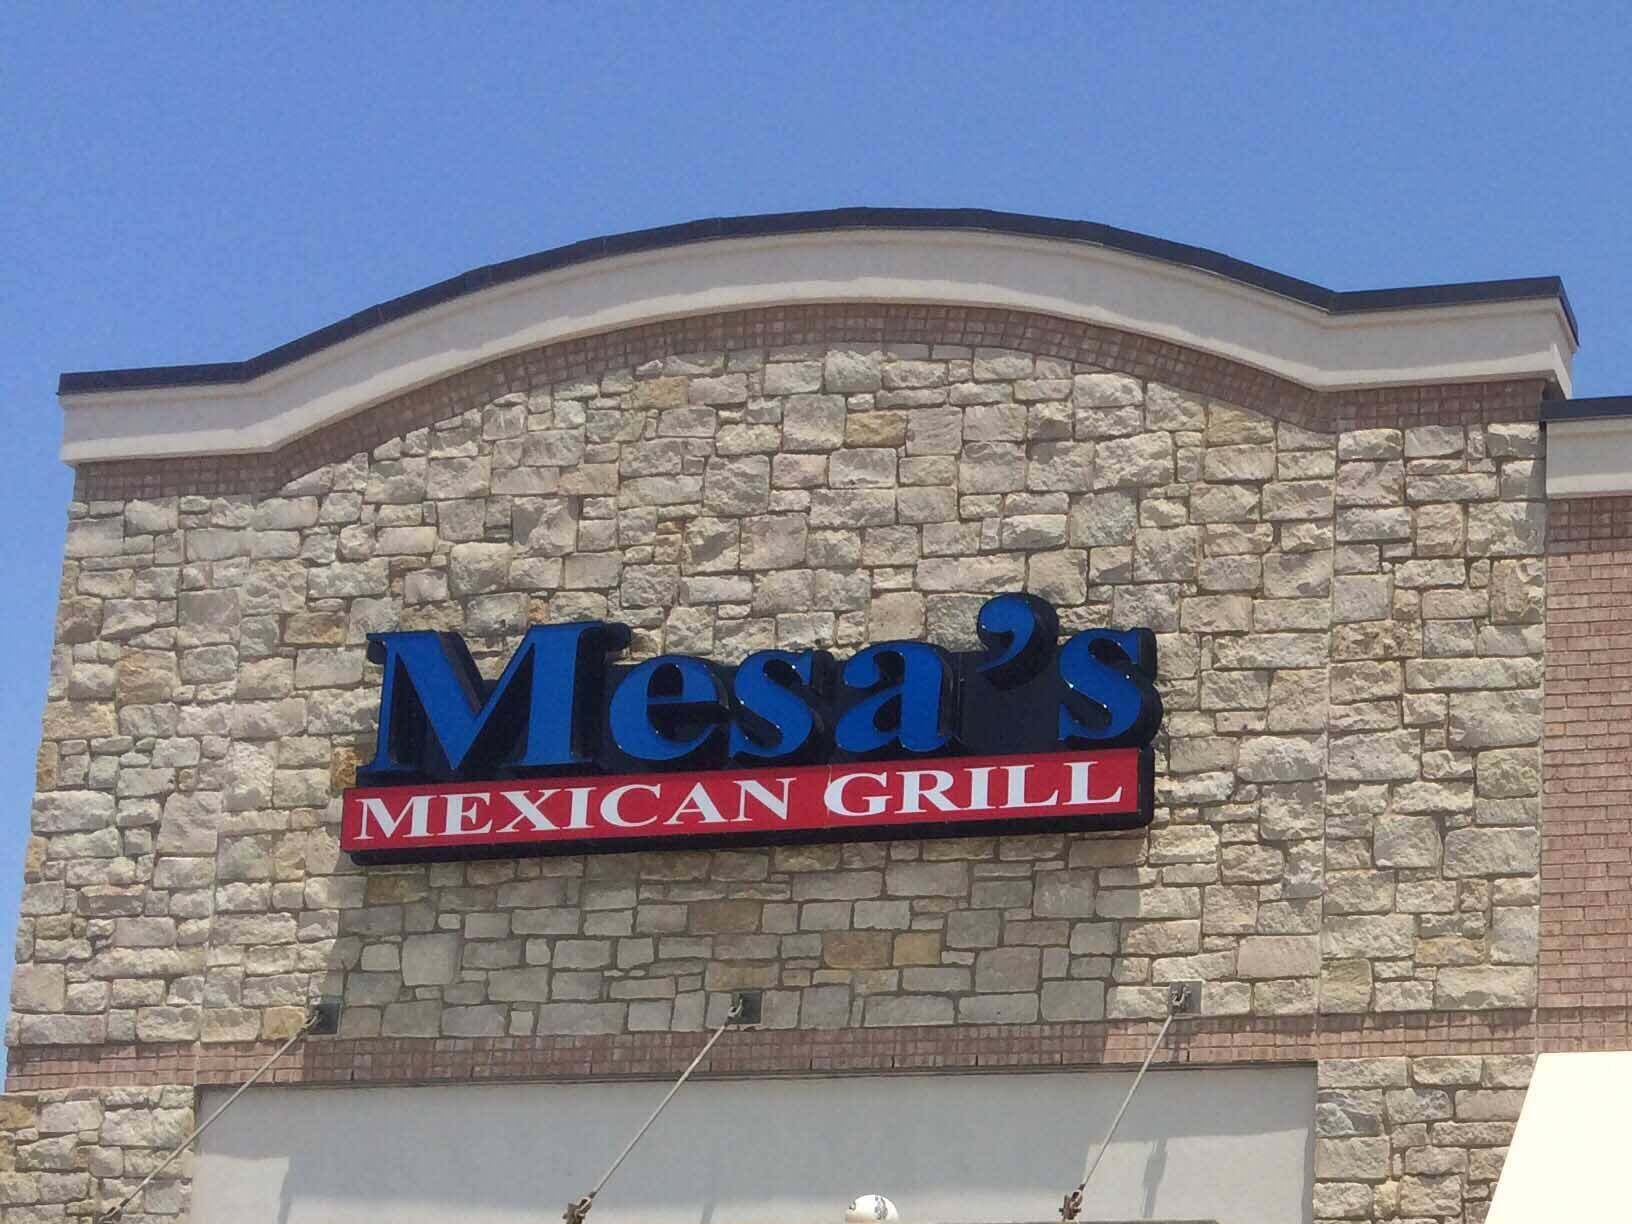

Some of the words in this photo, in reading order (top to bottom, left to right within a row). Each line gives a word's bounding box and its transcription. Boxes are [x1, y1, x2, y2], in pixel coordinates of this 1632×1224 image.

[366, 592, 1146, 773] Mesa's
[352, 777, 797, 843] MEXICAN
[824, 759, 1125, 817] GRILL
